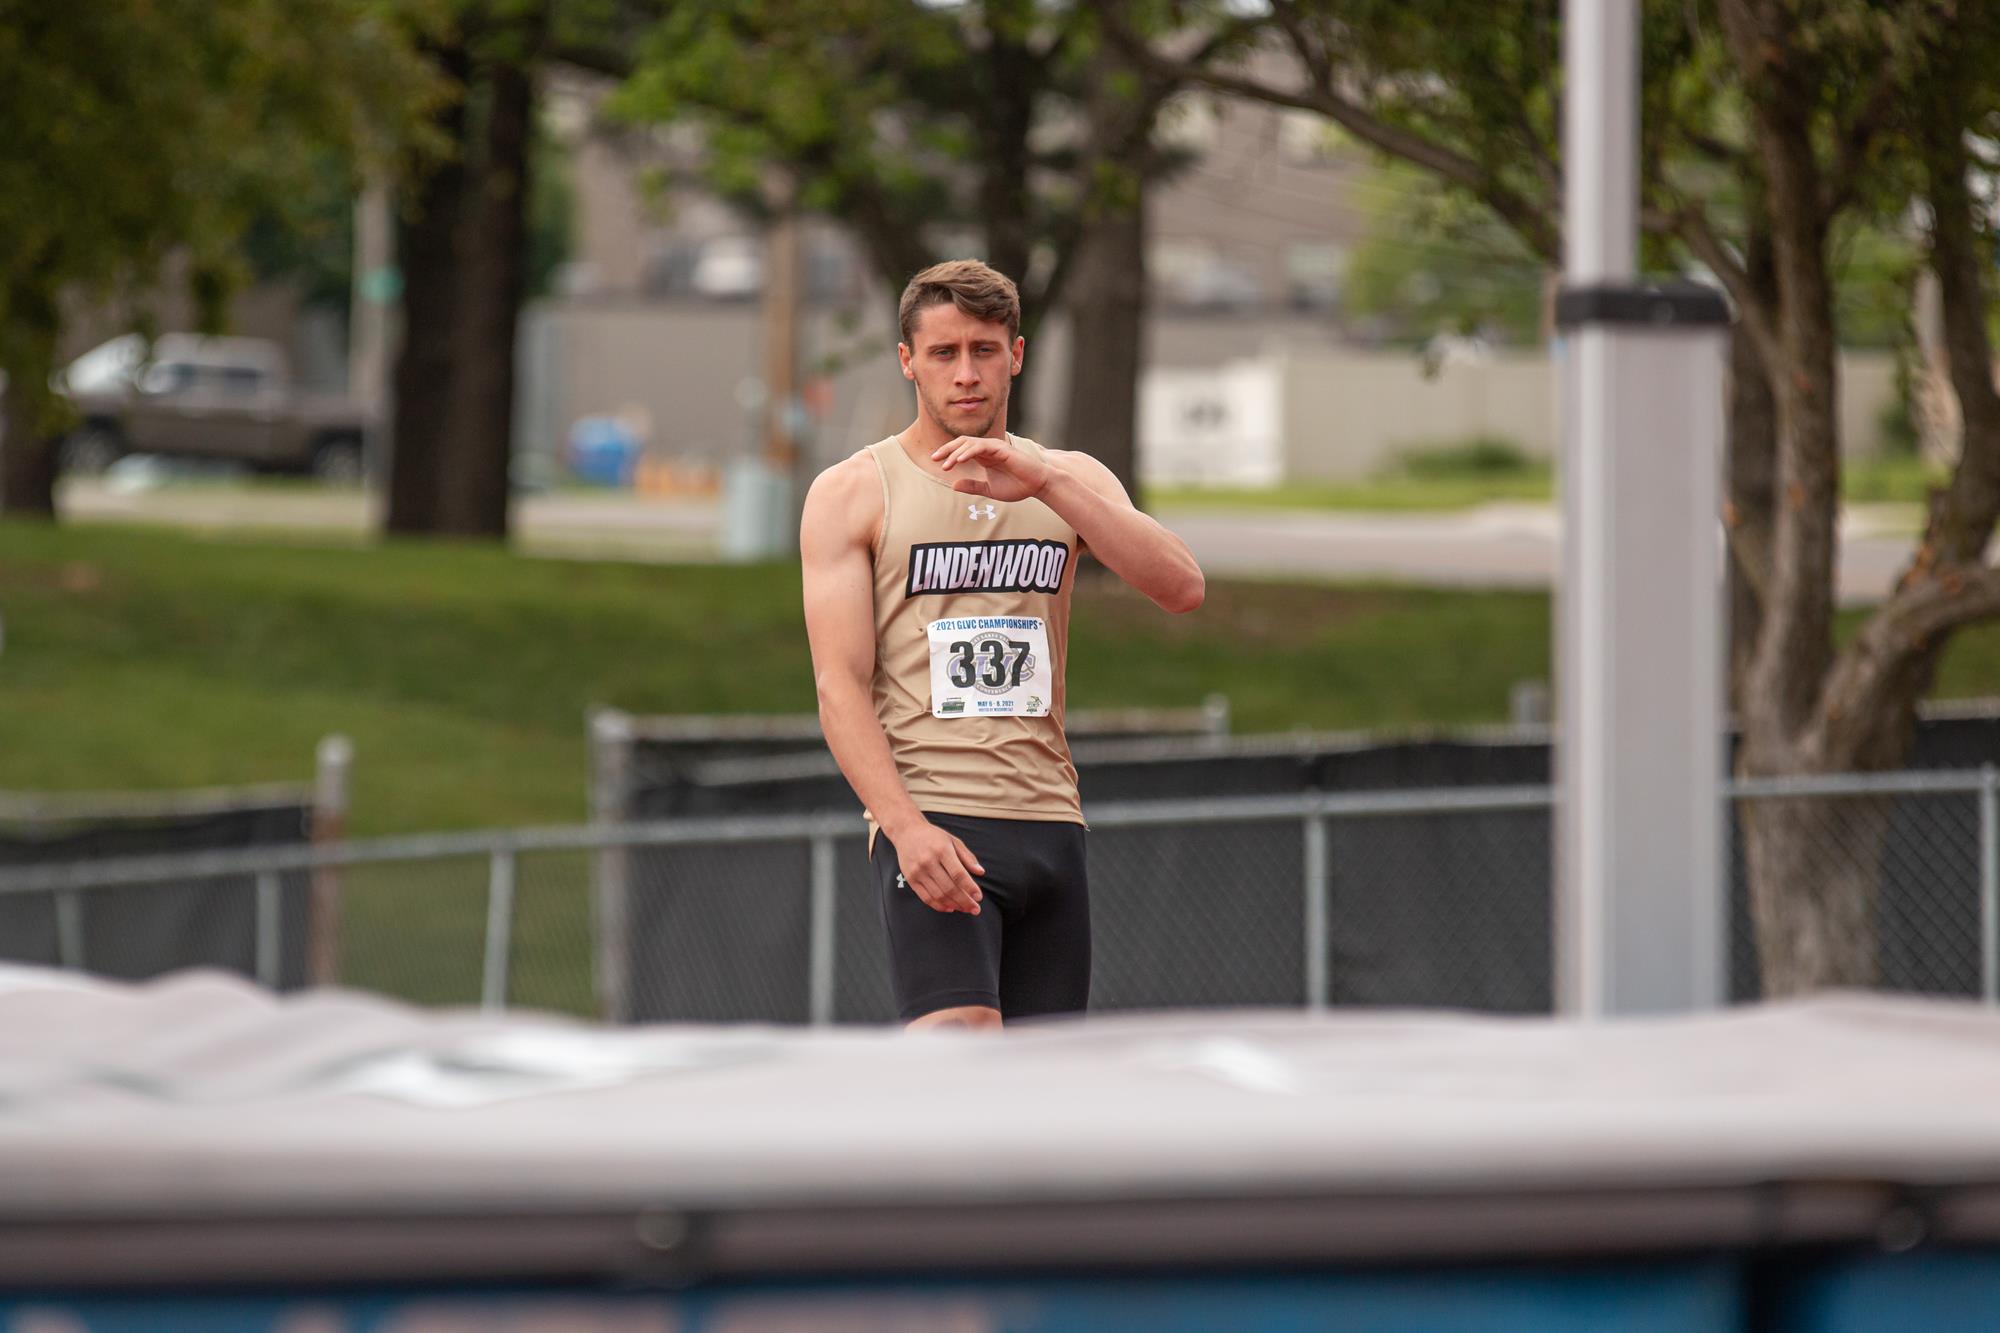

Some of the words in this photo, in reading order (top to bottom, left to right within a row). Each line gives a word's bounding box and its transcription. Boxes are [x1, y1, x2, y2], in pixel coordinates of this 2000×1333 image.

[911, 543, 1067, 594] LINDENWOOD
[936, 621, 956, 631] 2021
[957, 619, 977, 630] GLVC
[978, 618, 1038, 631] CHAMPIONSHIPS
[950, 640, 1030, 689] 337
